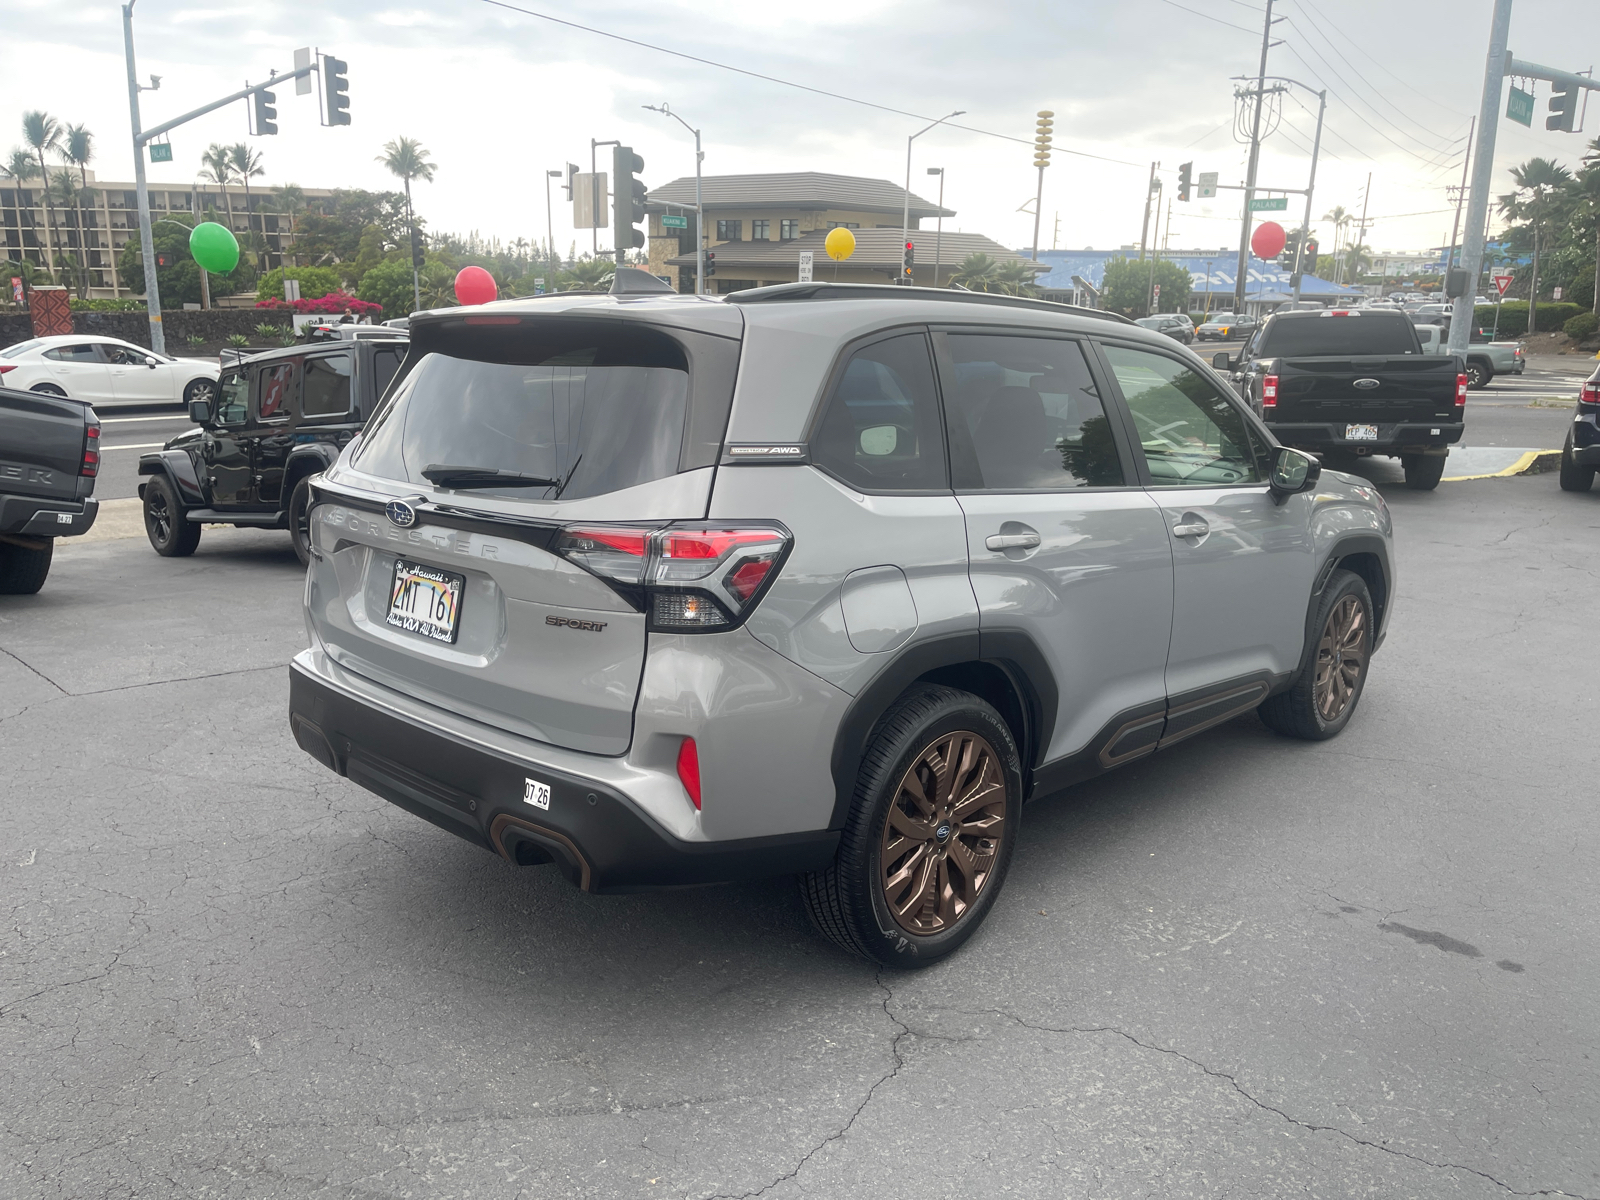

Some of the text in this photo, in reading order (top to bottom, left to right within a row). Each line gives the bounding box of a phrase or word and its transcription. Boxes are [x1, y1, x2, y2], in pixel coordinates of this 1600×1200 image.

[151, 148, 167, 158] PALANI
[1251, 201, 1277, 209] PALANI
[801, 255, 812, 265] STOP
[768, 446, 801, 455] AWD
[333, 506, 501, 561] FORESTER
[409, 565, 444, 582] Hawaii
[392, 576, 455, 624] ZMT 161
[385, 612, 403, 628] Aloha
[419, 622, 431, 636] All
[429, 625, 453, 643] Islands
[545, 615, 608, 632] SPORT
[980, 710, 1014, 752] TURANZA
[524, 781, 549, 806] 07 26
